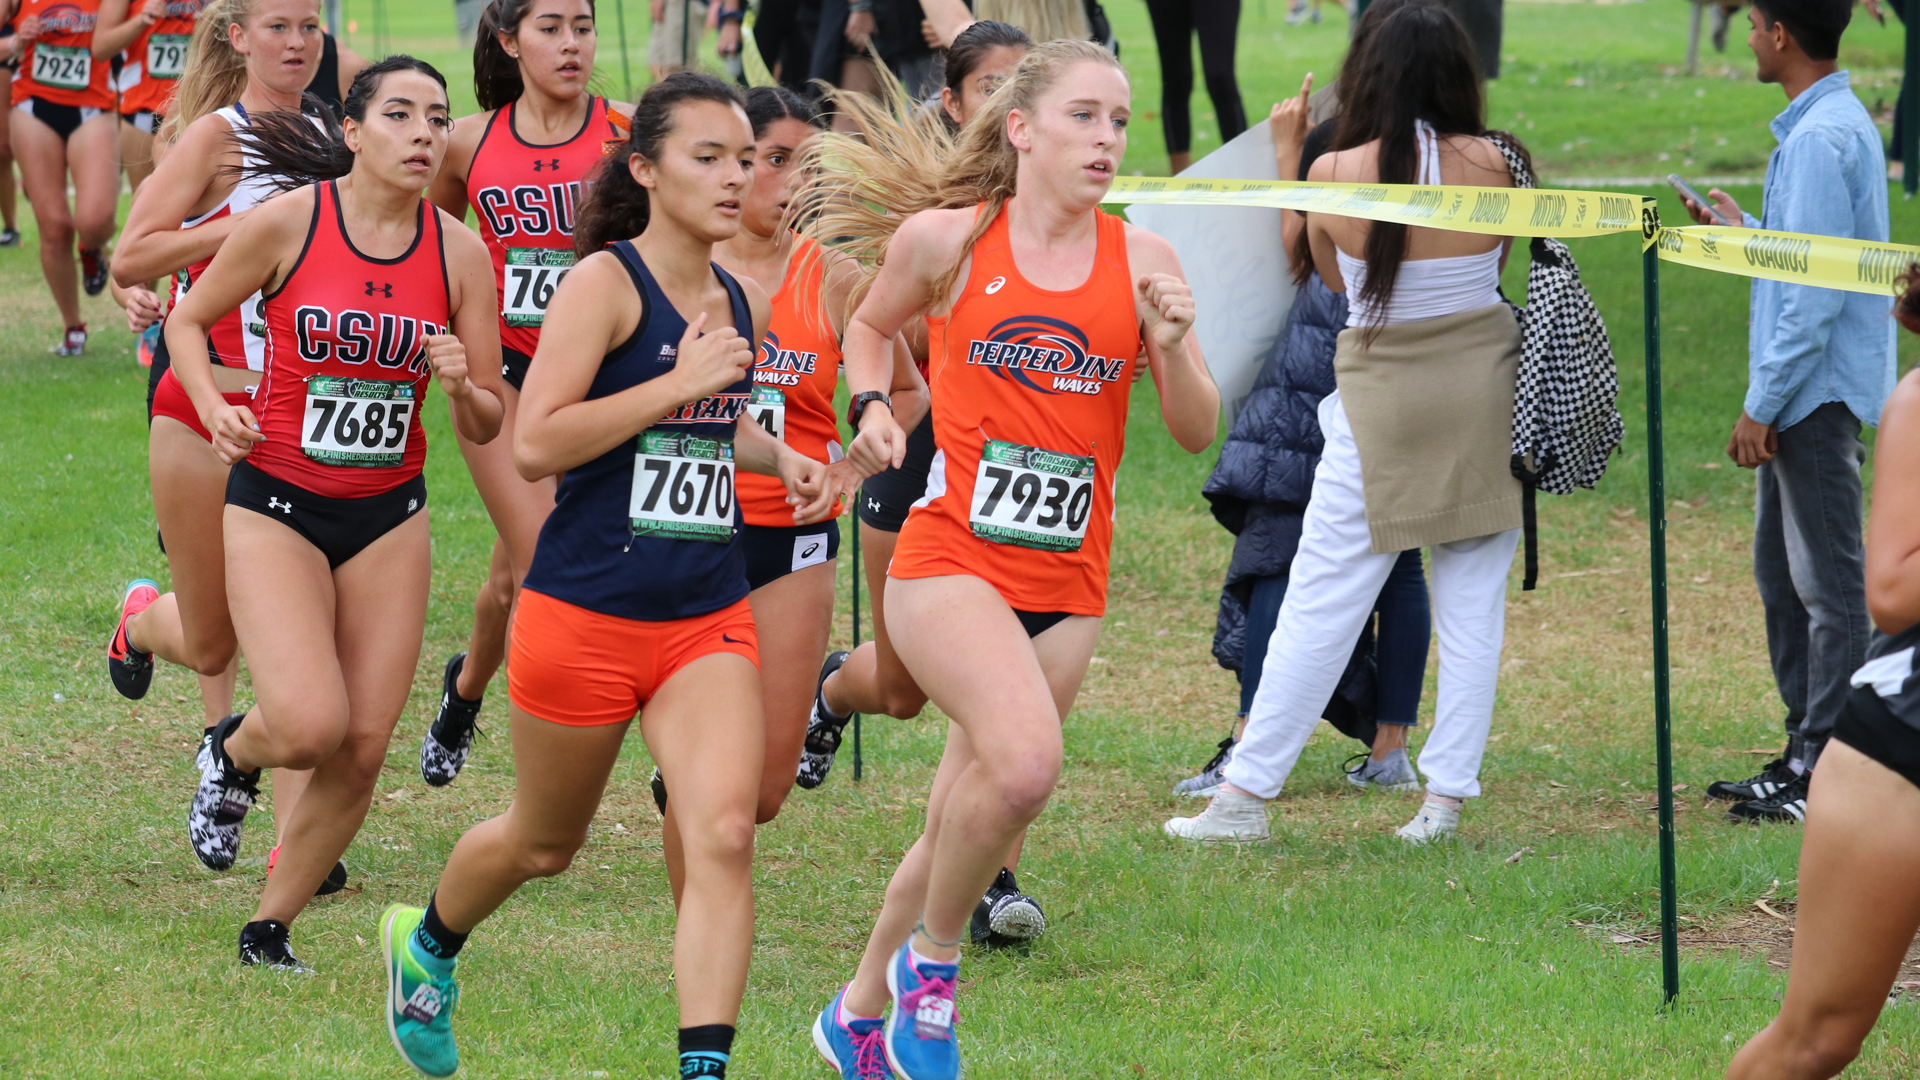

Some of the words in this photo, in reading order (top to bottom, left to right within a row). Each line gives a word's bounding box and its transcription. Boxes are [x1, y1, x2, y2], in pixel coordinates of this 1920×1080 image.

[36, 54, 87, 81] 7924
[153, 46, 188, 69] 79
[477, 180, 596, 238] CSU
[511, 268, 571, 310] 76
[967, 336, 1126, 382] PEPPERDINE
[753, 371, 800, 386] WAVES
[1052, 376, 1103, 395] WAVES
[309, 398, 410, 449] 7685
[1034, 462, 1073, 476] RESULTS
[1038, 452, 1077, 467] FINISHED
[640, 458, 732, 519] 7670
[978, 466, 1092, 532] 7930
